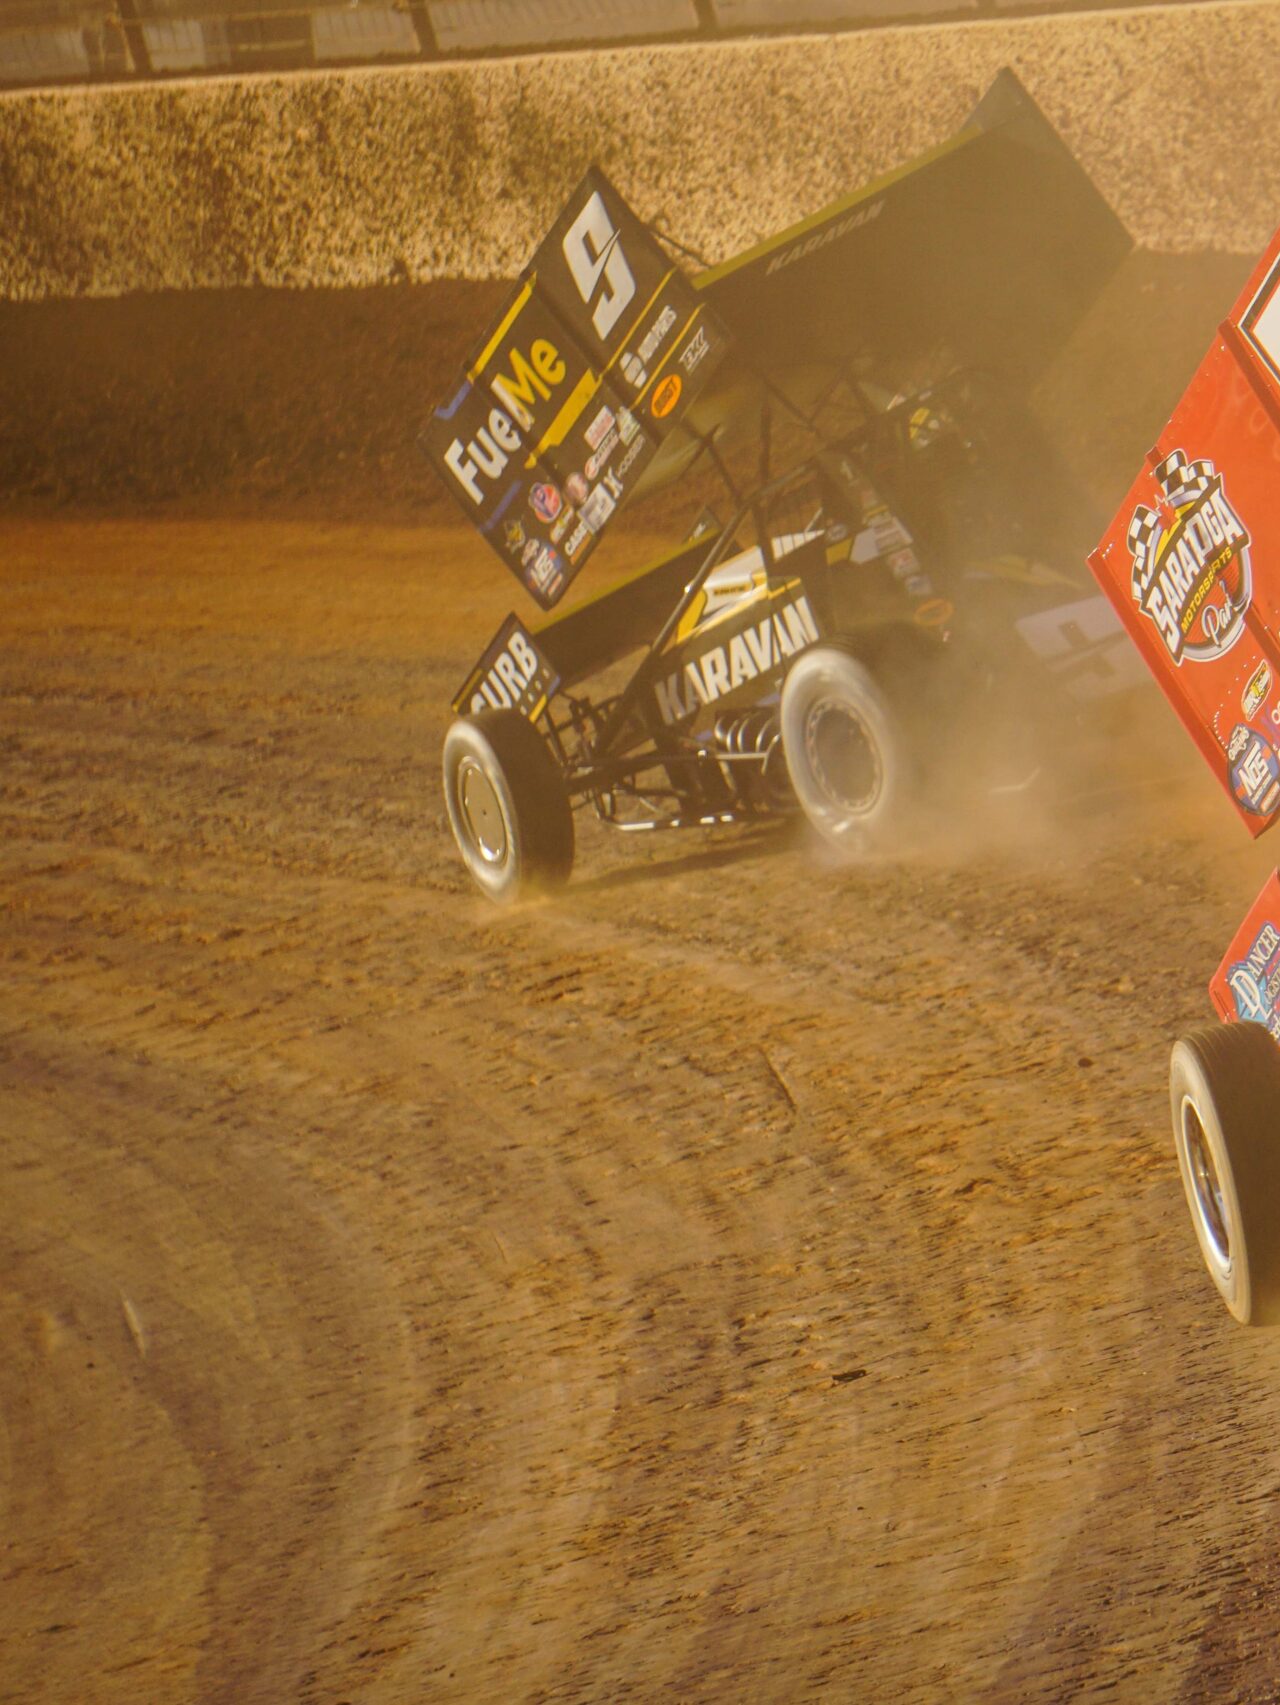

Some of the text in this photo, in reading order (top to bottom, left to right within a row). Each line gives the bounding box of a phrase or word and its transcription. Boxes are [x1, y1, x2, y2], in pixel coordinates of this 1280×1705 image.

[1147, 488, 1245, 653] SARATOGA
[1180, 546, 1233, 634] MOTORSPRTS
[654, 595, 820, 726] KARAVAN
[1237, 740, 1270, 797] NOS
[1229, 925, 1280, 1018] DANCER
